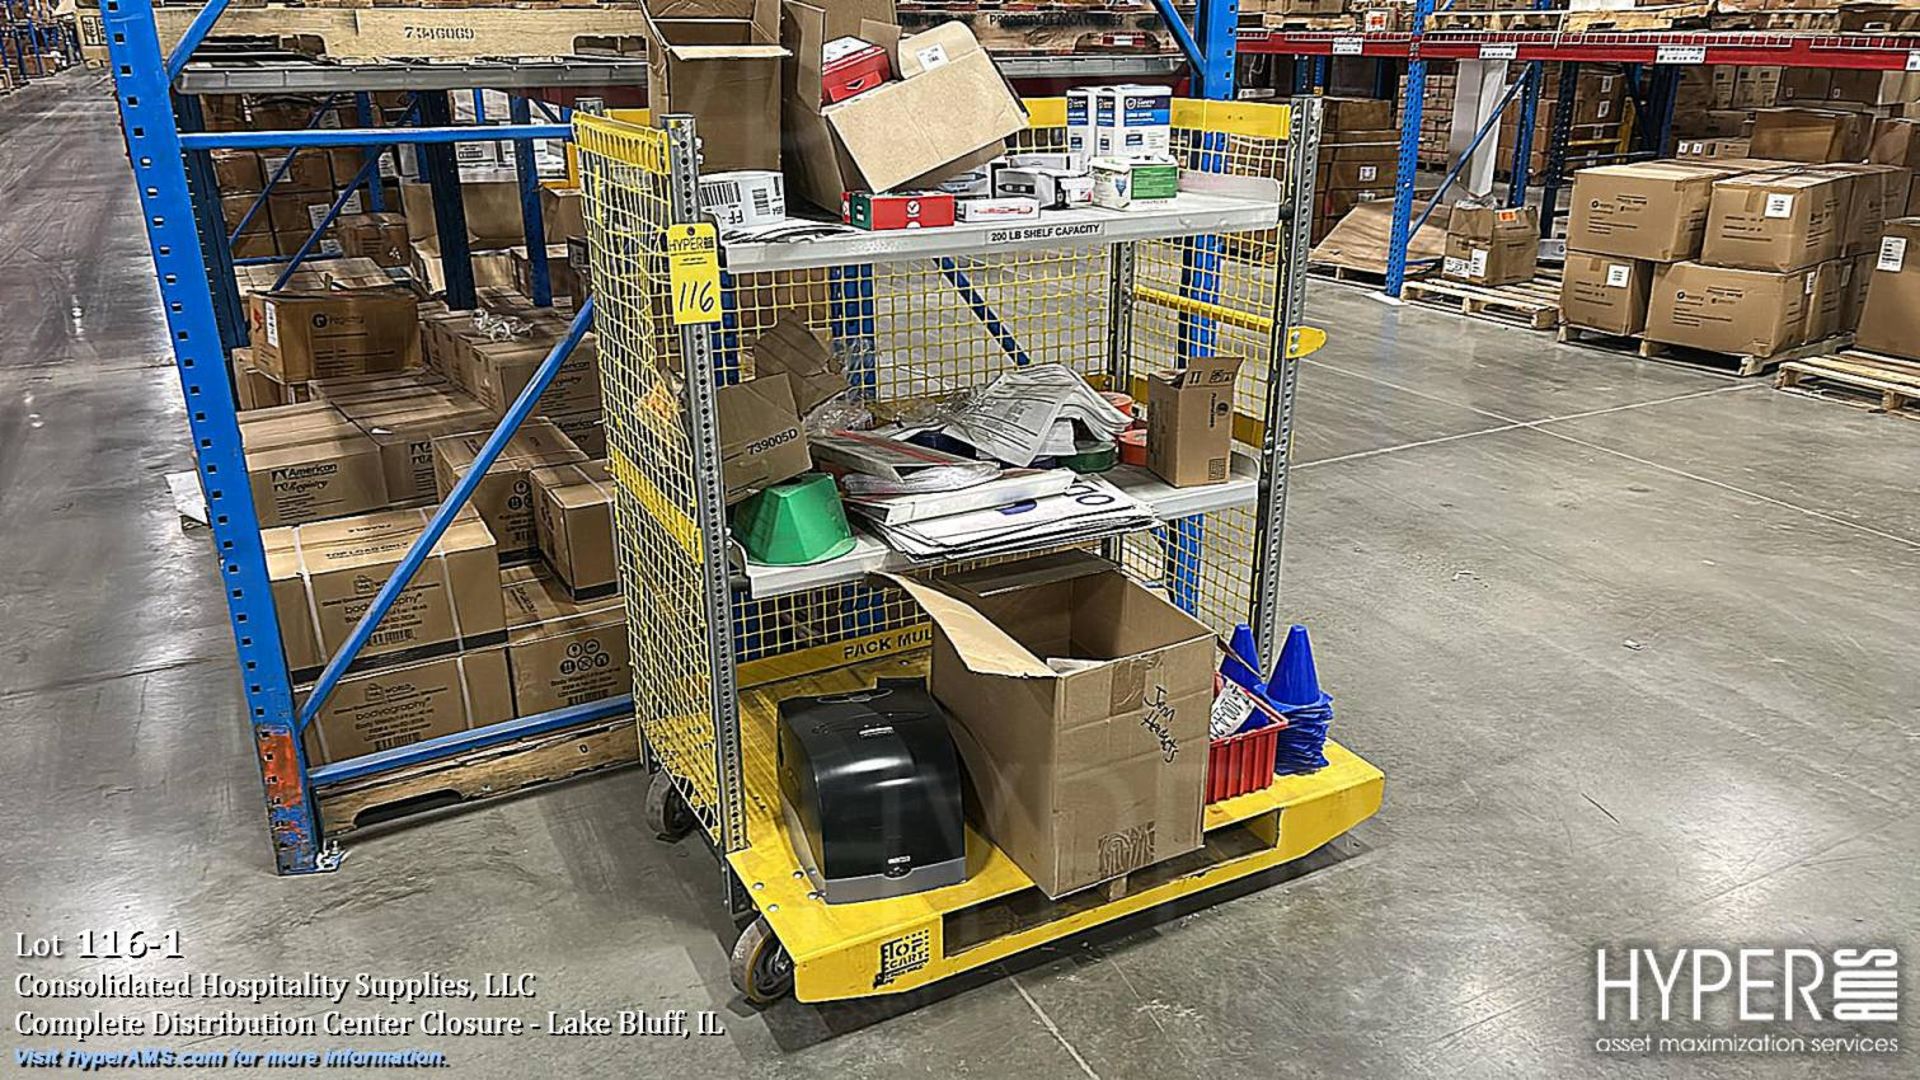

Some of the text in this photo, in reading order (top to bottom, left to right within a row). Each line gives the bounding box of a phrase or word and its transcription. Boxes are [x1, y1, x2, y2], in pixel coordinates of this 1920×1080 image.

[991, 223, 1100, 242] 200 LB SHELF CAPACITY
[679, 280, 715, 313] 116
[746, 428, 798, 455] 739005D
[289, 463, 338, 478] American
[843, 636, 892, 660] PACK
[889, 950, 925, 969] CART
